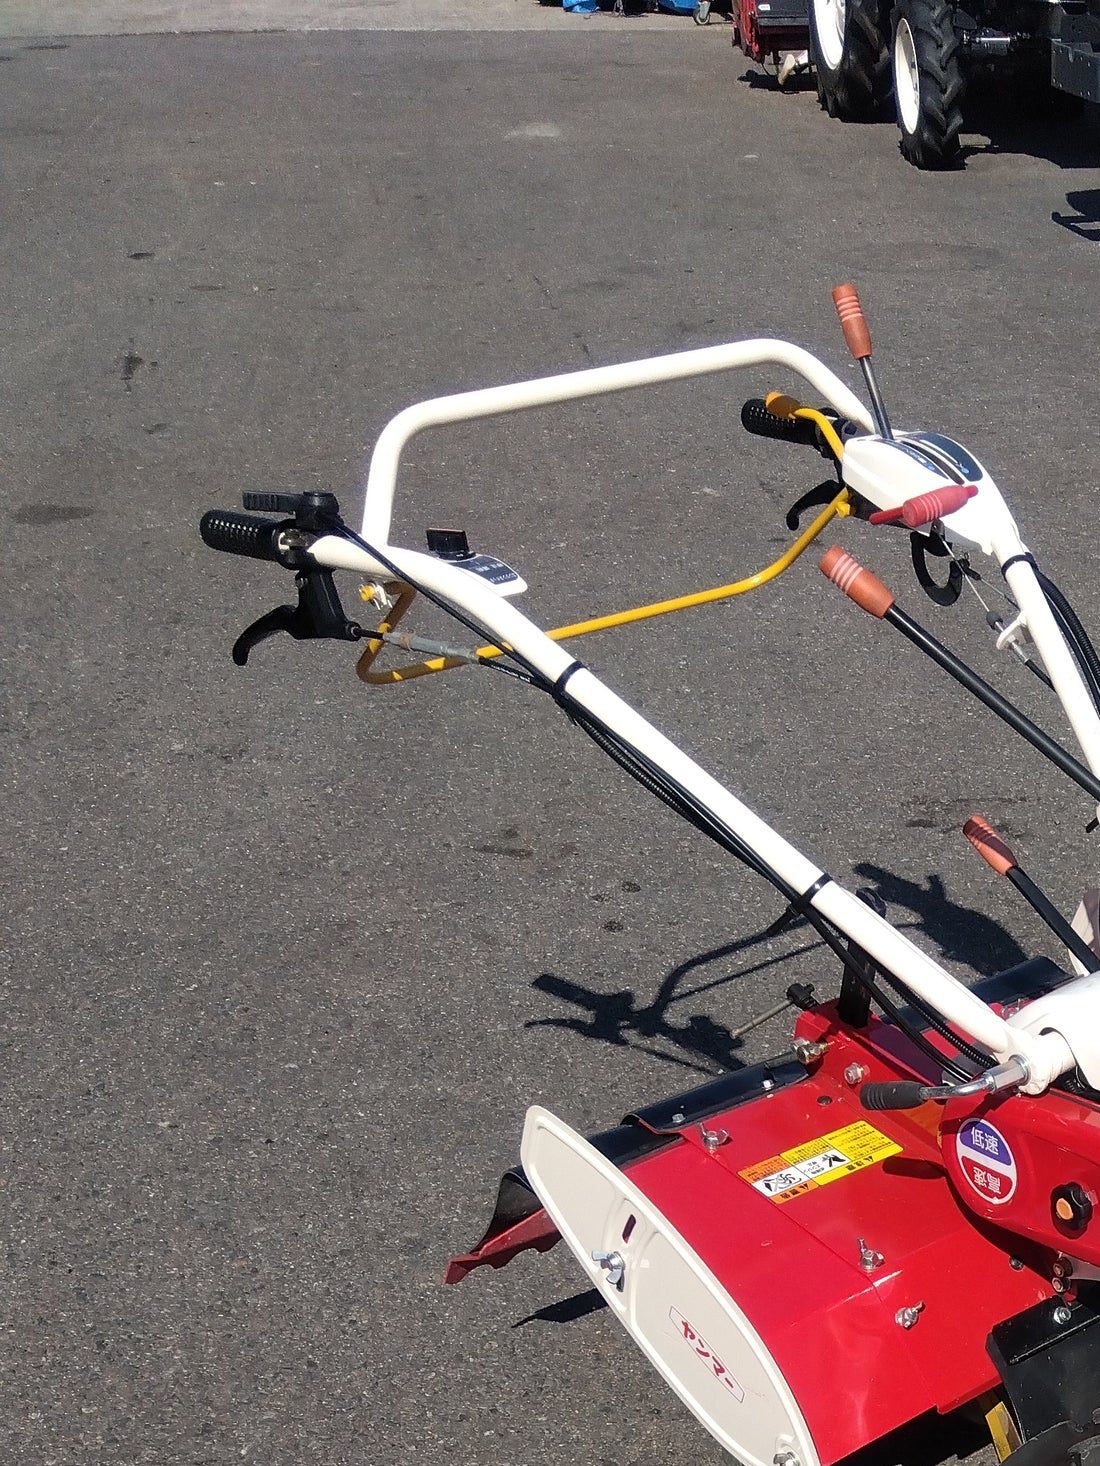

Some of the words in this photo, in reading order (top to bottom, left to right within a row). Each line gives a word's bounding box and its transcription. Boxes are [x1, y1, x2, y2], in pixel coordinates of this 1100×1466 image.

[971, 1127, 999, 1155] 低速
[973, 1166, 1001, 1194] 高速
[681, 1320, 734, 1389] ヤンマー
